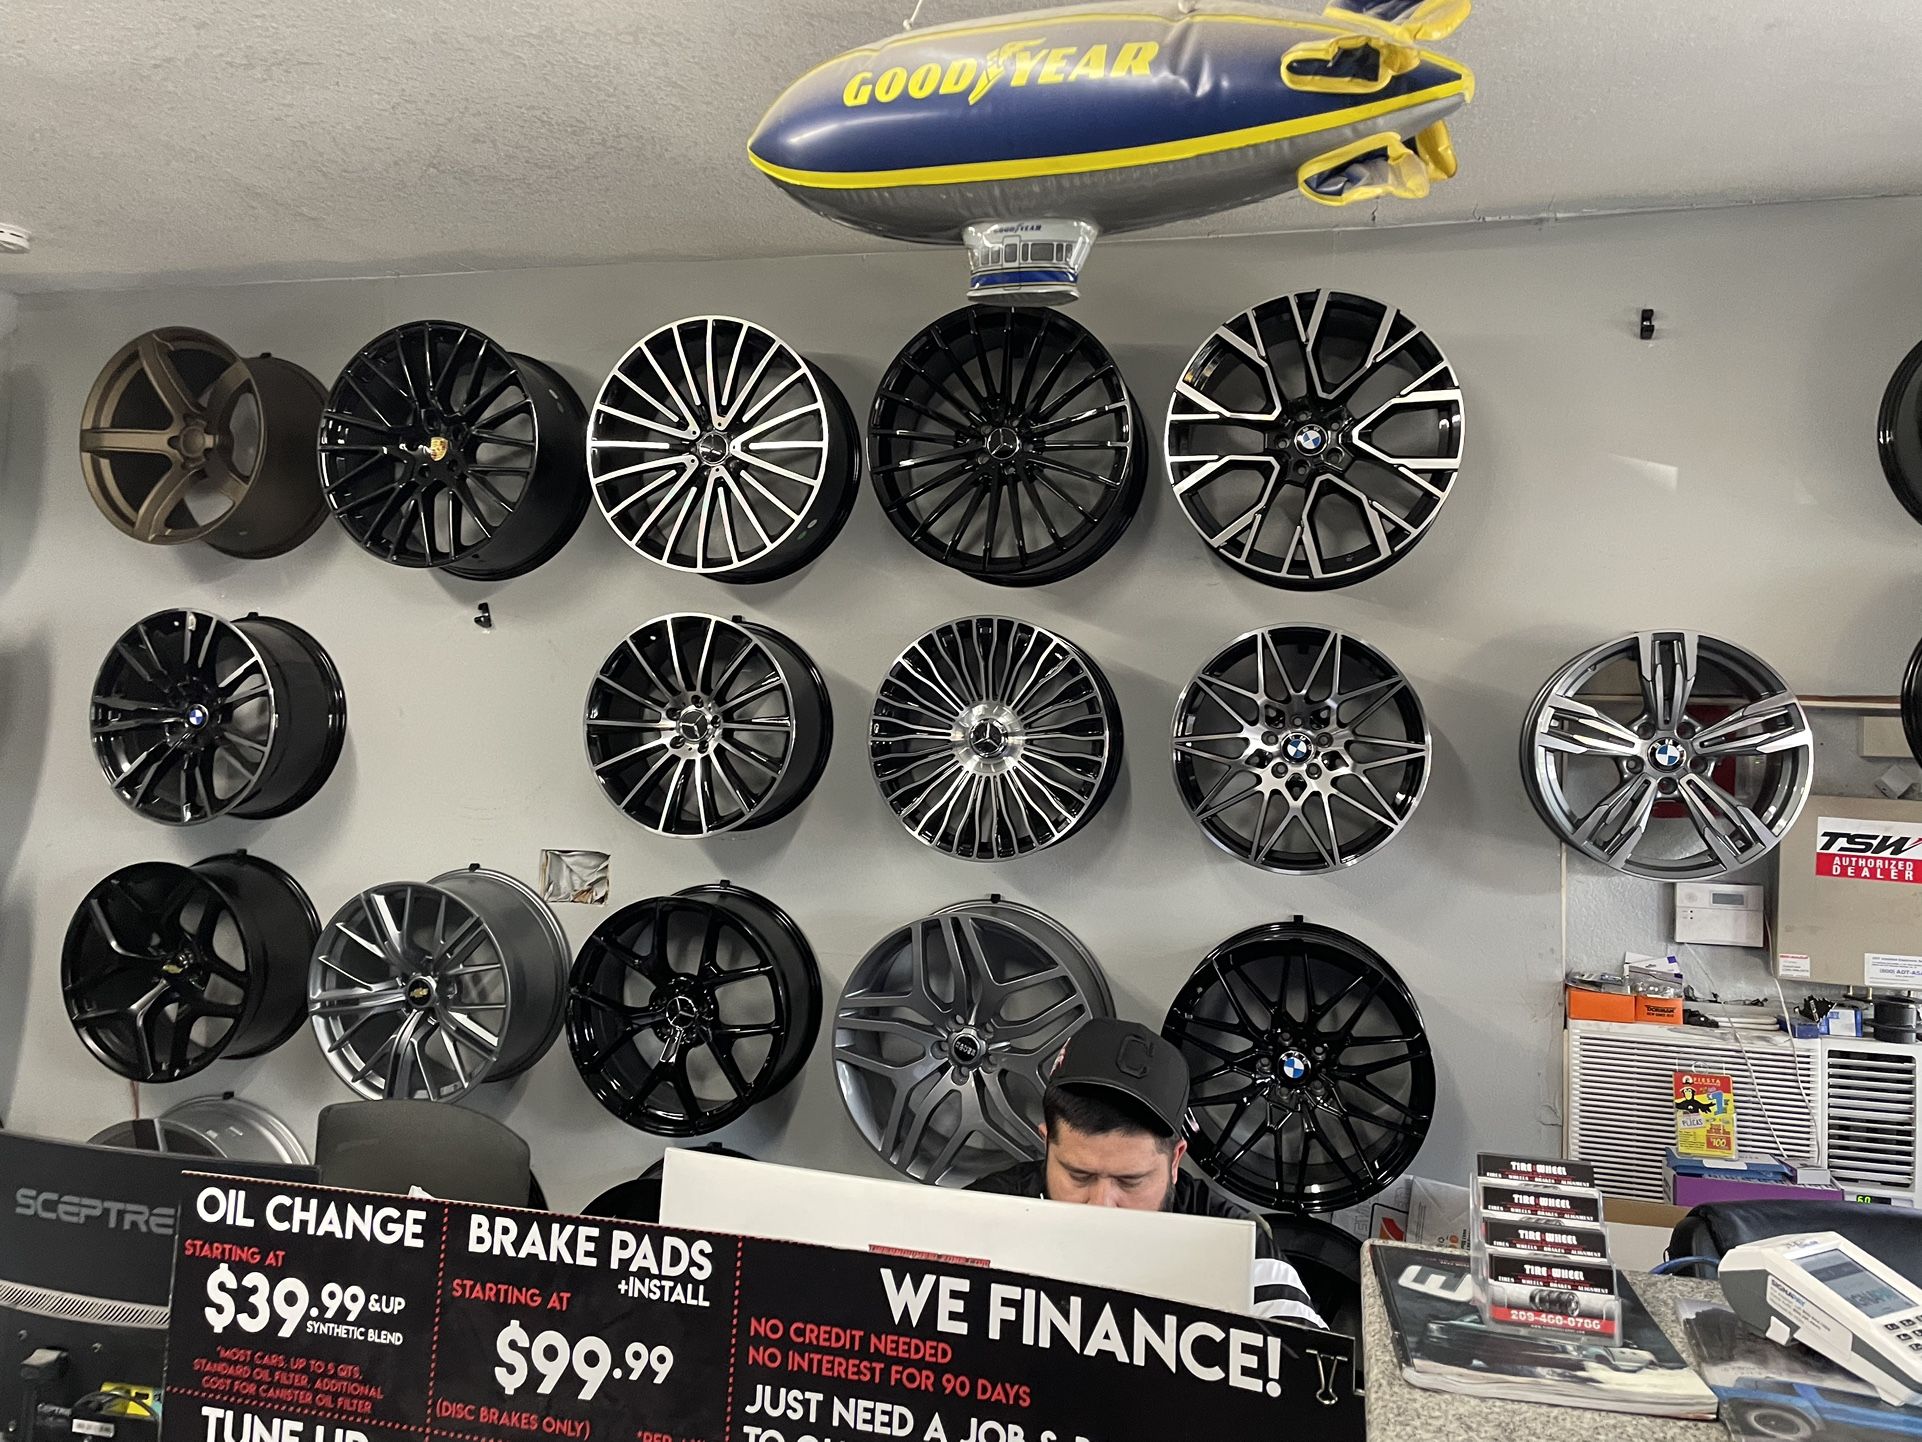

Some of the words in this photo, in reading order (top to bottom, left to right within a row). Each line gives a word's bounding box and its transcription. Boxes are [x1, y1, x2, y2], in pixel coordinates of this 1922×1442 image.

[1820, 831, 1913, 856] TSW
[1832, 865, 1914, 881] DEALER
[1833, 856, 1914, 871] AUTHORIZED
[15, 1187, 177, 1236] SCEPTRE
[196, 1186, 255, 1228] OIL
[265, 1194, 427, 1248] CHANGE
[184, 1238, 262, 1265] STARTING
[264, 1250, 286, 1268] AT
[468, 1213, 600, 1267] BRAKE
[610, 1230, 713, 1281] PADS
[368, 1293, 406, 1315] &UP
[452, 1278, 542, 1307] STARTING
[547, 1292, 571, 1312] AT
[617, 1276, 710, 1307] +INSTALL
[306, 1320, 365, 1341] SYNTHETIC
[367, 1327, 404, 1346] BLEND
[750, 1316, 784, 1340] NO
[789, 1322, 864, 1350] CREDIT
[870, 1333, 953, 1364] NEEDED
[880, 1268, 970, 1335] WE
[989, 1283, 1282, 1398] FINANCE!
[193, 1357, 251, 1377] STANDARD
[253, 1367, 272, 1382] OIL
[314, 1377, 384, 1400] ADDITIONAL
[290, 1357, 307, 1370] UP
[310, 1359, 325, 1373] TO
[494, 1319, 674, 1401] $99.99
[748, 1345, 782, 1368] NO
[788, 1350, 884, 1384] INTEREST
[890, 1364, 935, 1393] FOR
[942, 1373, 970, 1399] 90
[977, 1378, 1032, 1408] DAYS
[202, 1375, 231, 1392] COST
[233, 1379, 257, 1396] FOR
[259, 1384, 313, 1405] CANISTER
[316, 1393, 335, 1409] OIL
[337, 1396, 373, 1414] FILTER
[745, 1384, 823, 1423] JUST
[832, 1397, 914, 1437] NEED
[923, 1412, 948, 1442] A
[960, 1417, 1025, 1442] JOB
[201, 1406, 304, 1442] TUNE
[436, 1398, 476, 1421] (DISC
[480, 1405, 539, 1431] BRAKES
[542, 1415, 592, 1441] ONLY)
